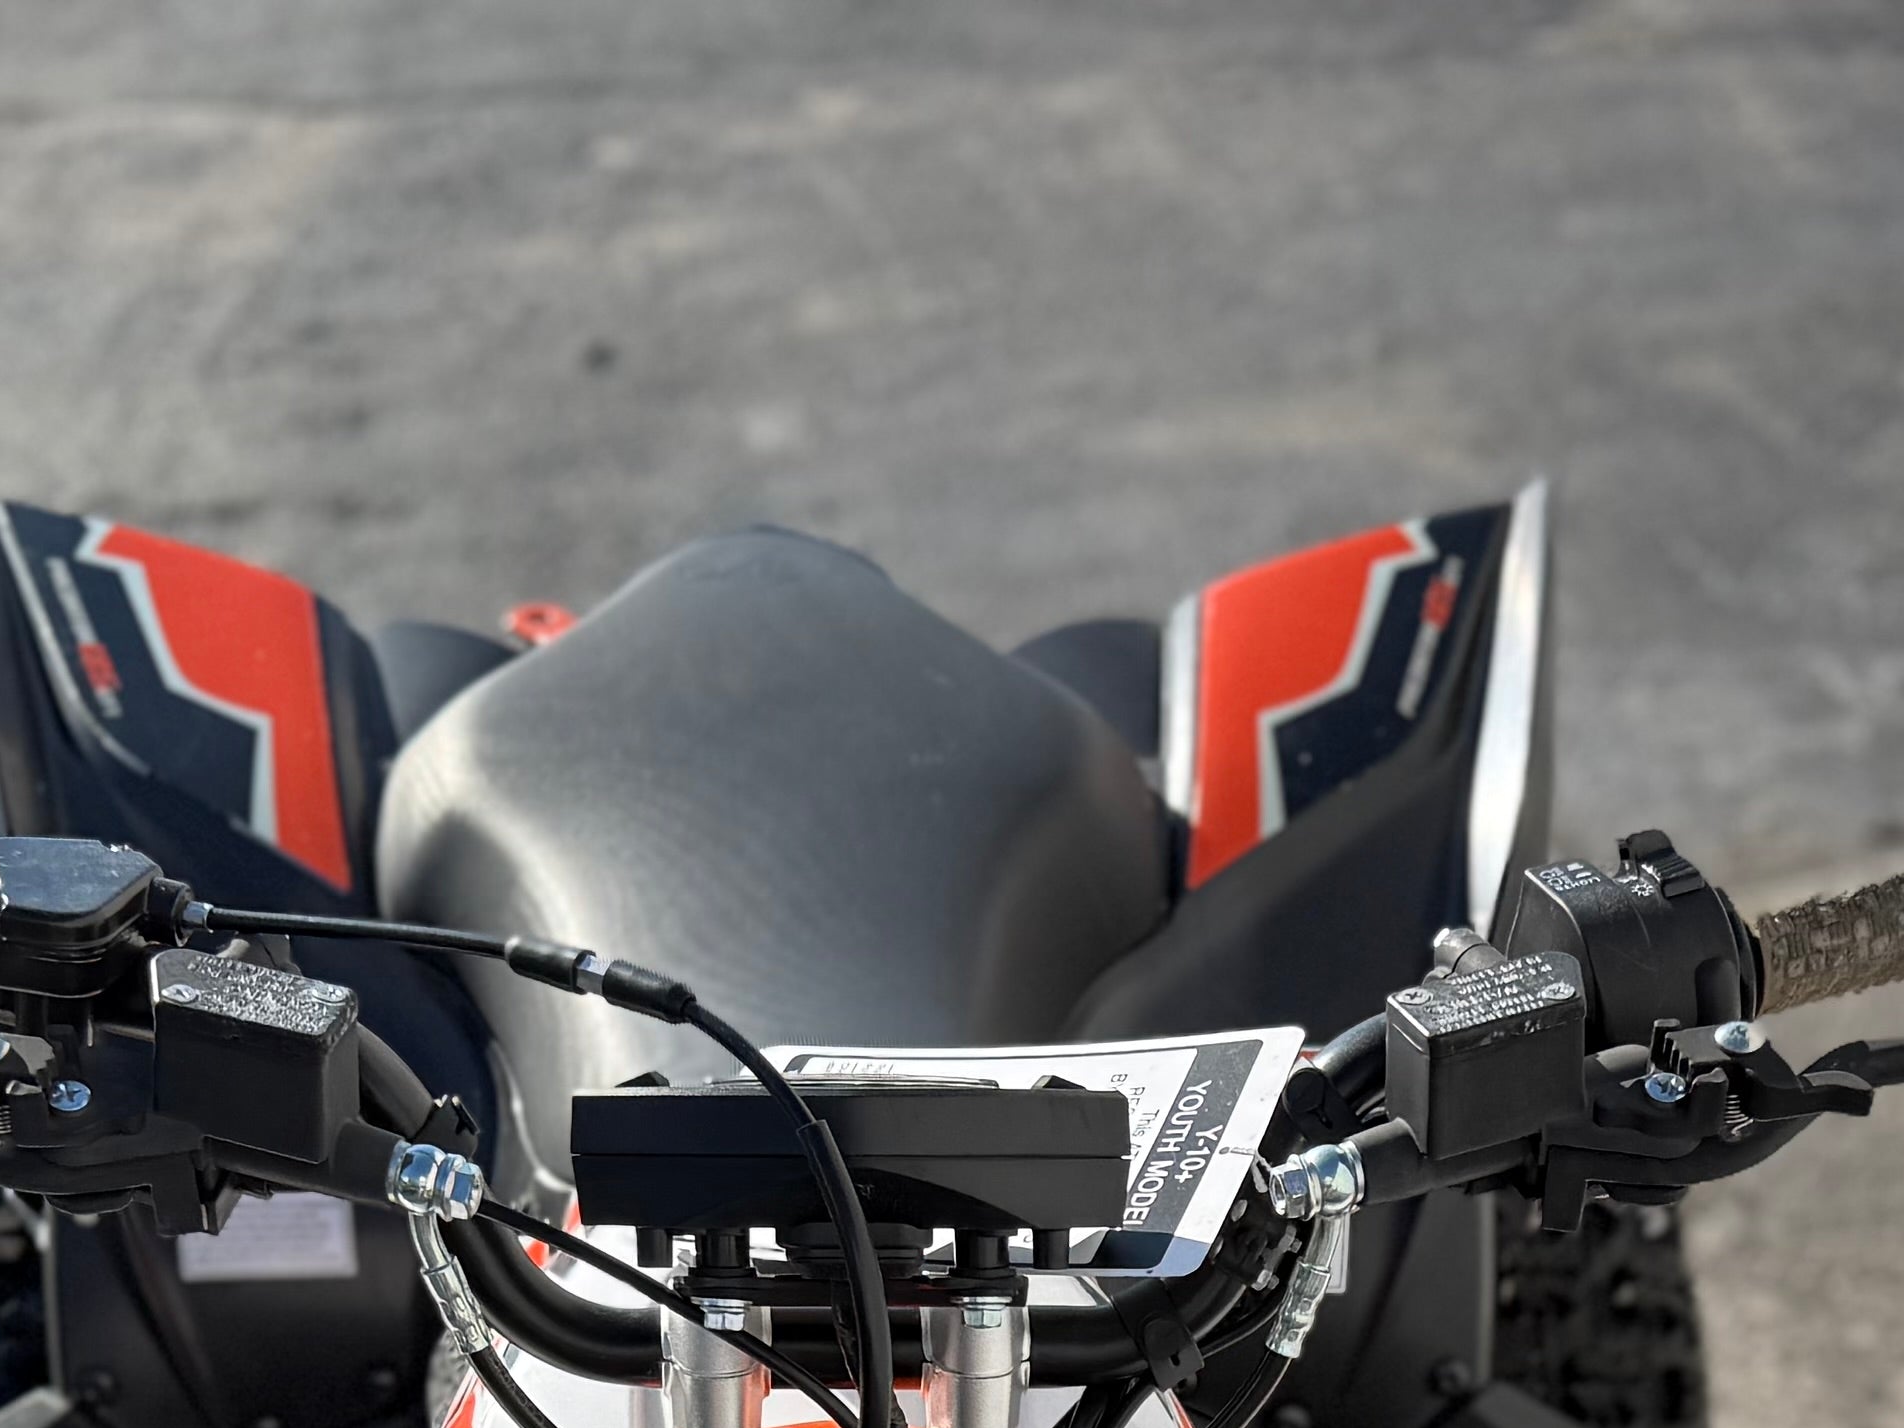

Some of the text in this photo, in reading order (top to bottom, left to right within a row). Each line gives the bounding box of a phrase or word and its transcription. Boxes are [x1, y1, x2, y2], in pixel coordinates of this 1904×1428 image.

[1132, 1109, 1160, 1137] This
[1156, 1079, 1212, 1153] YOUTH
[1174, 1125, 1223, 1183] Y-10+
